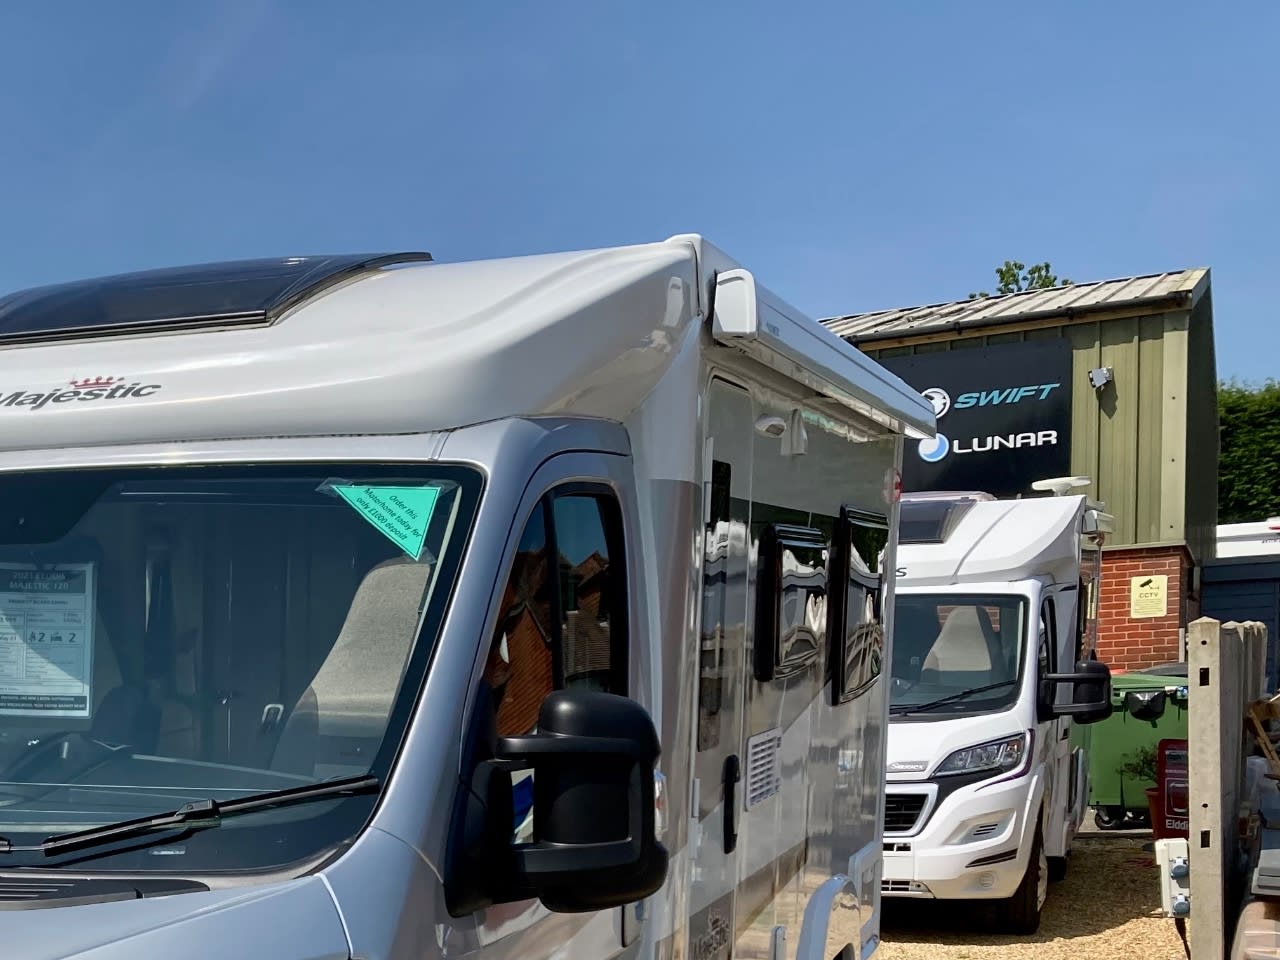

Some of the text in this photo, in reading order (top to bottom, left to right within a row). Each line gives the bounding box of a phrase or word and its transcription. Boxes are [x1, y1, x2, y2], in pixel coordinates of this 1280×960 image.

[953, 383, 1061, 409] SWIFT
[952, 430, 1058, 454] LUNAR
[363, 488, 396, 517] Motorhome
[395, 516, 412, 530] today
[389, 495, 418, 520] Order this
[38, 631, 46, 642] 2
[68, 632, 76, 643] 2
[1165, 820, 1188, 830] Elddi
